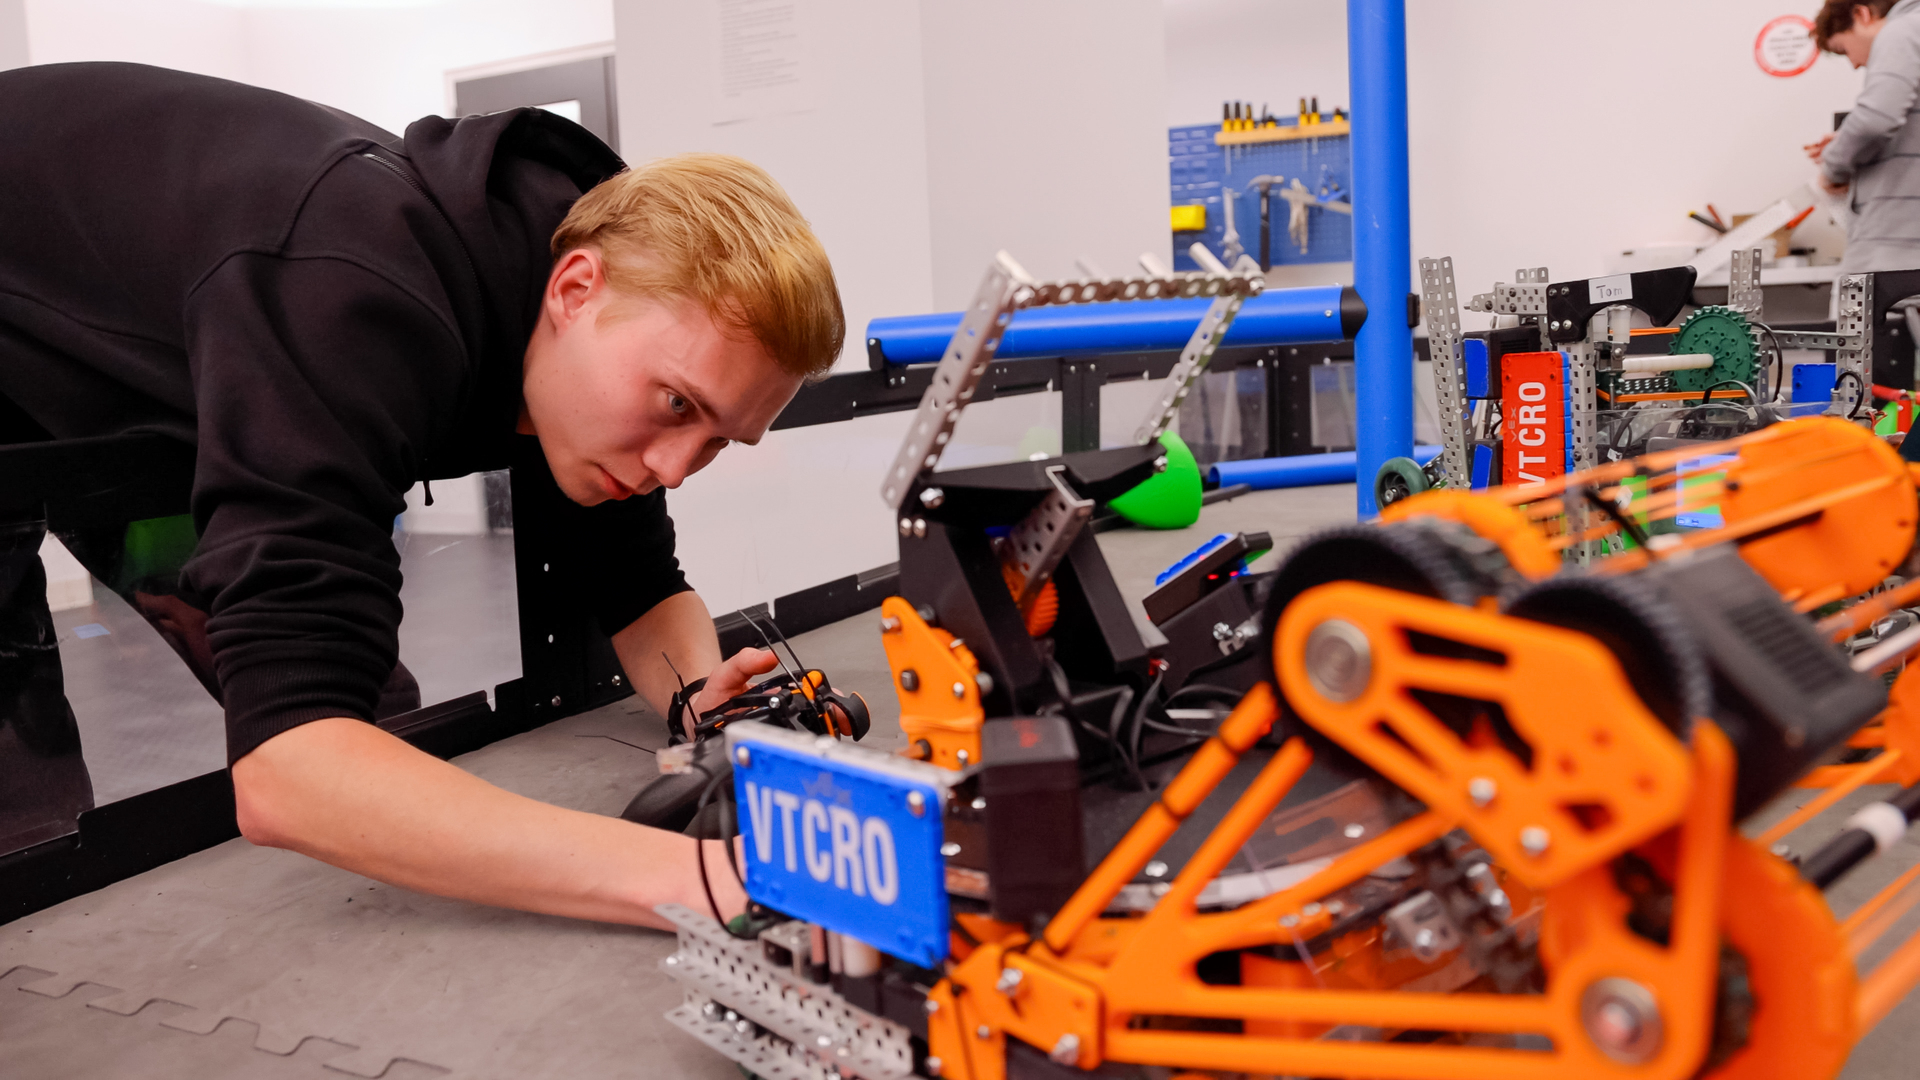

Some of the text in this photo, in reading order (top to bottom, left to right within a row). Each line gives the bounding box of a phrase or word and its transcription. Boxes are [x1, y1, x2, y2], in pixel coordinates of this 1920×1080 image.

[1595, 284, 1623, 299] Tom
[1508, 406, 1517, 443] VEX
[1518, 382, 1546, 490] VTCRO
[745, 781, 899, 906] VTCRO
